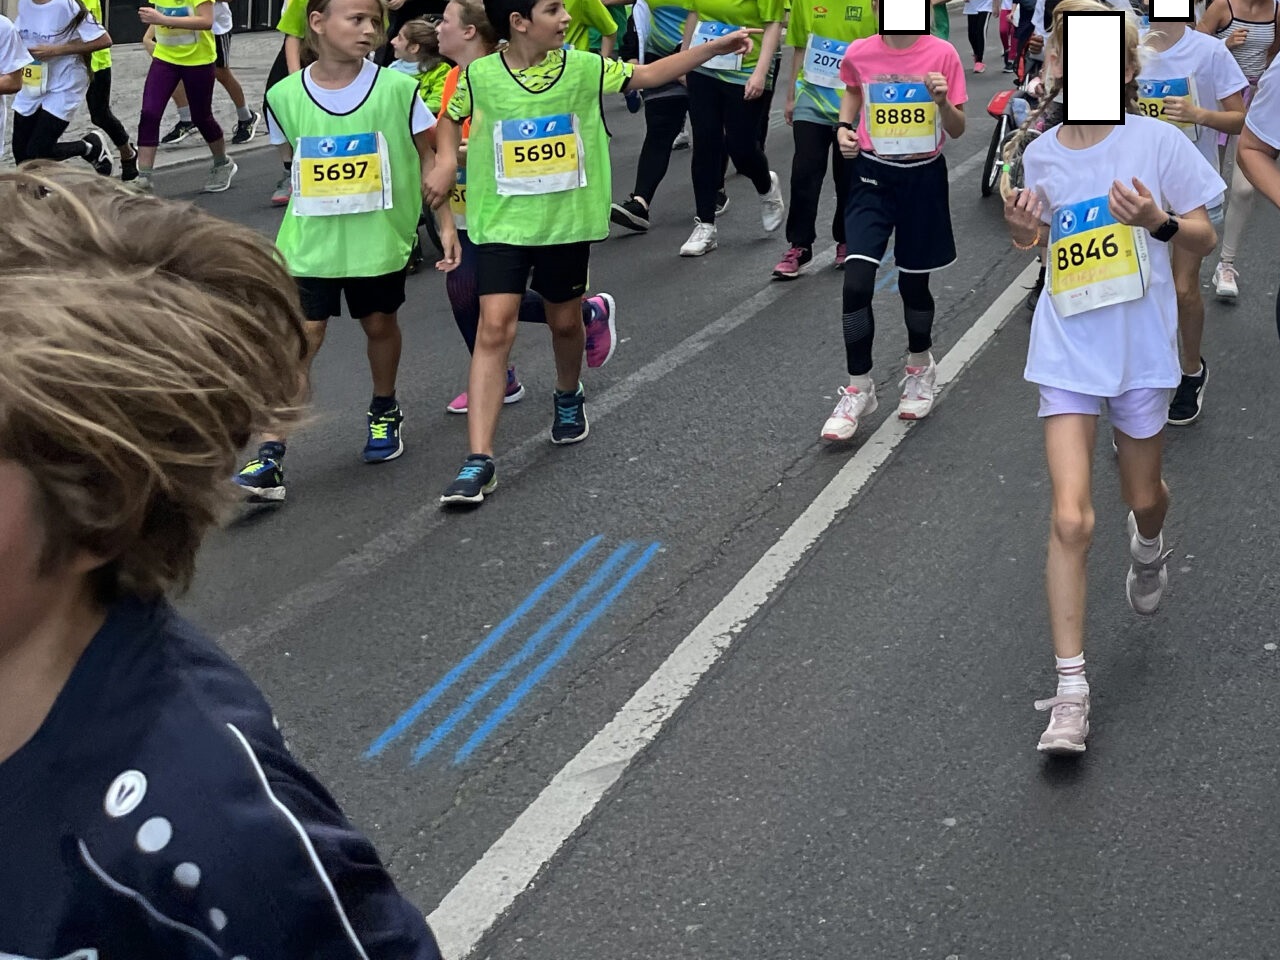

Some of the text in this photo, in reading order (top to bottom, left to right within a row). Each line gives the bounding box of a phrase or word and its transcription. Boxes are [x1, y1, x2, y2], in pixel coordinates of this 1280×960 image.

[876, 108, 926, 125] 8888
[514, 142, 566, 163] 5690
[313, 161, 369, 182] 5697
[1057, 233, 1119, 271] 8846
